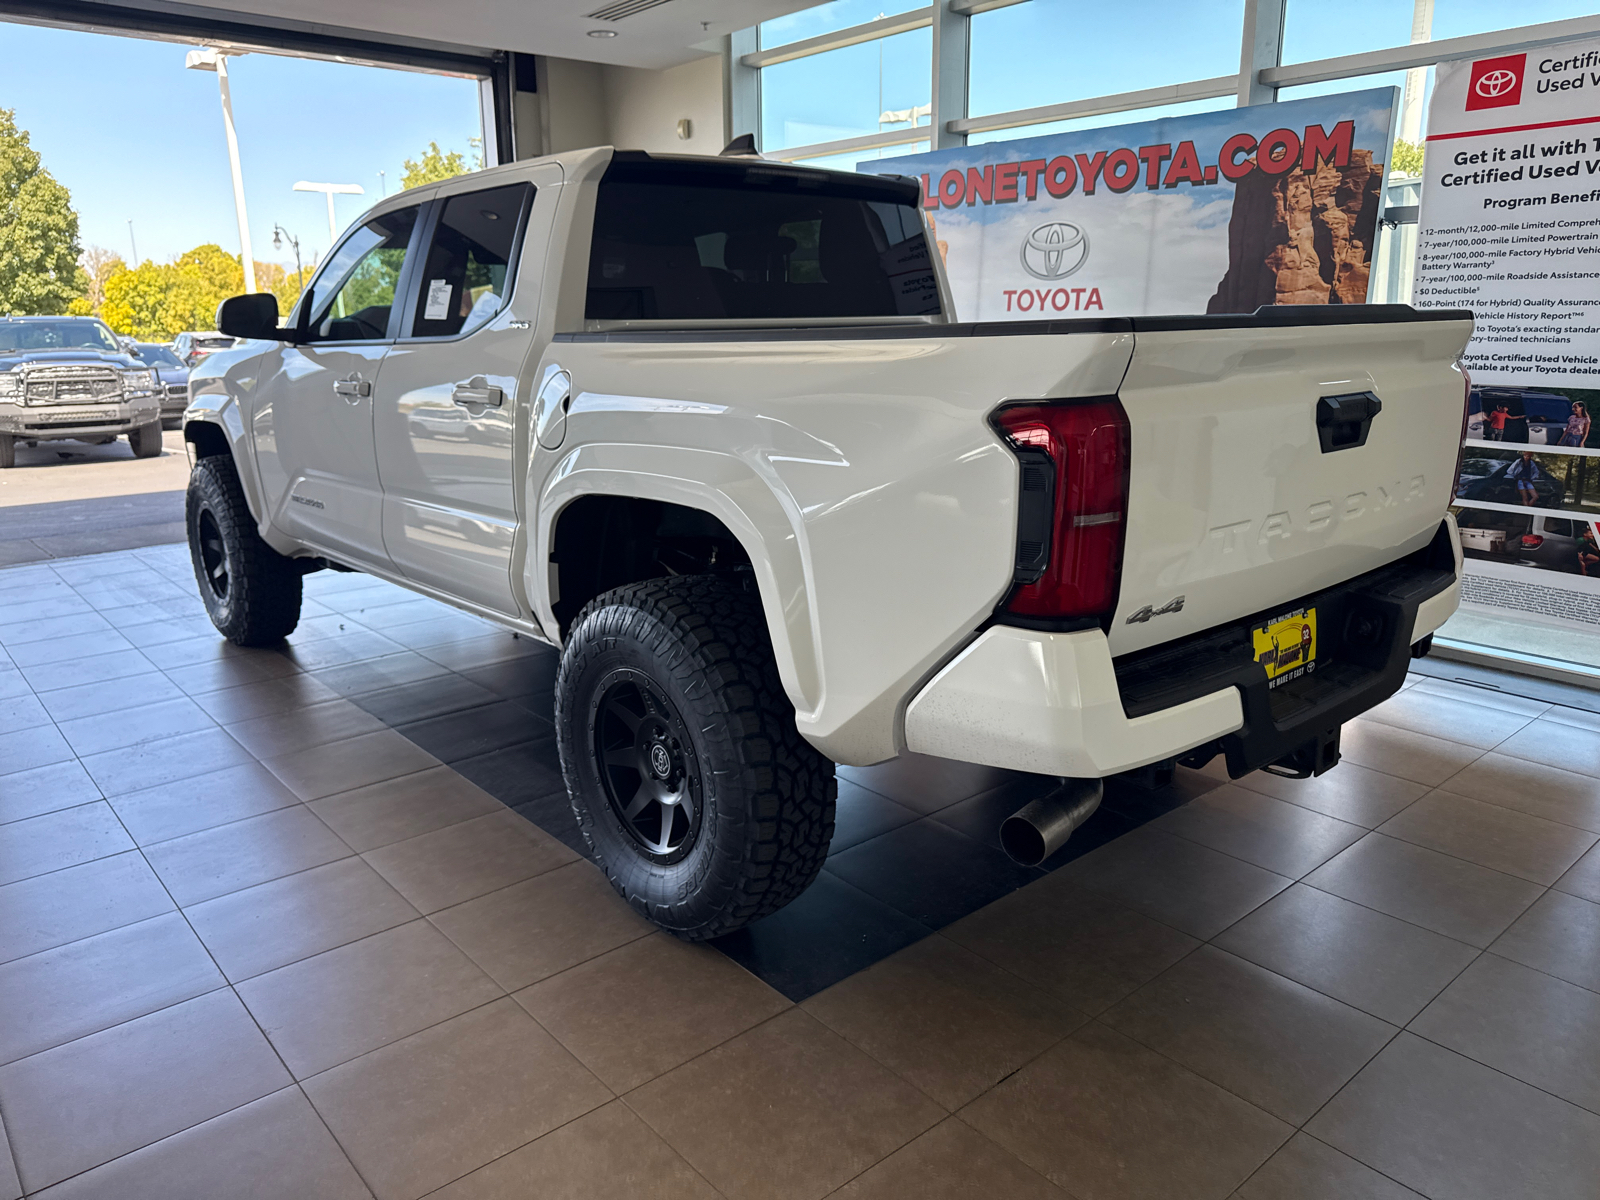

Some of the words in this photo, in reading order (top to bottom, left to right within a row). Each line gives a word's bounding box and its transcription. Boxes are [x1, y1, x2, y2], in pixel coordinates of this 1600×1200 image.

[1538, 51, 1600, 74] Certifi
[1536, 73, 1585, 94] Used
[1453, 149, 1488, 166] Get
[1492, 147, 1506, 163] it
[1510, 144, 1536, 160] all
[1540, 138, 1587, 158] with
[1440, 165, 1524, 187] Certified
[1528, 160, 1580, 179] Used
[1483, 195, 1547, 210] Program
[1424, 222, 1520, 236] 12-month/12,000-mile
[1521, 220, 1556, 230] Limited
[1424, 236, 1510, 249] 7-year/100,000-mile
[1511, 234, 1545, 244] Limited
[1547, 232, 1599, 242] Powertrain
[1422, 249, 1507, 262] 8-year/100,000-mile
[1508, 249, 1542, 259] Factory
[1543, 247, 1575, 258] Hybrid
[1421, 263, 1451, 272] Battery
[1420, 273, 1505, 284] 7-year/100,000-mile
[1506, 272, 1549, 281] Roadside
[1419, 287, 1430, 296] $0
[1002, 287, 1105, 313] TOYOTA
[1418, 299, 1457, 308] 160-Point
[1457, 299, 1474, 309] (174
[1476, 299, 1489, 307] for
[1489, 298, 1522, 309] Hybrid)
[1523, 298, 1556, 309] Quality
[1474, 311, 1505, 320] Vehicle
[1506, 312, 1539, 322] History
[1476, 325, 1486, 333] to
[1487, 325, 1522, 334] Toyota's
[1523, 326, 1562, 335] exacting
[1520, 335, 1571, 344] technicians
[1491, 353, 1533, 363] Certified
[1535, 354, 1560, 363] Used
[1561, 355, 1599, 364] Vehicle
[1499, 364, 1509, 372] at
[1510, 366, 1533, 374] your
[1535, 365, 1568, 375] Toyota
[1208, 474, 1426, 553] TACOMA
[1302, 628, 1310, 640] 32
[1268, 680, 1276, 690] WE
[1276, 674, 1289, 687] MAKE
[1288, 671, 1294, 681] IT
[1293, 666, 1305, 679] EASY
